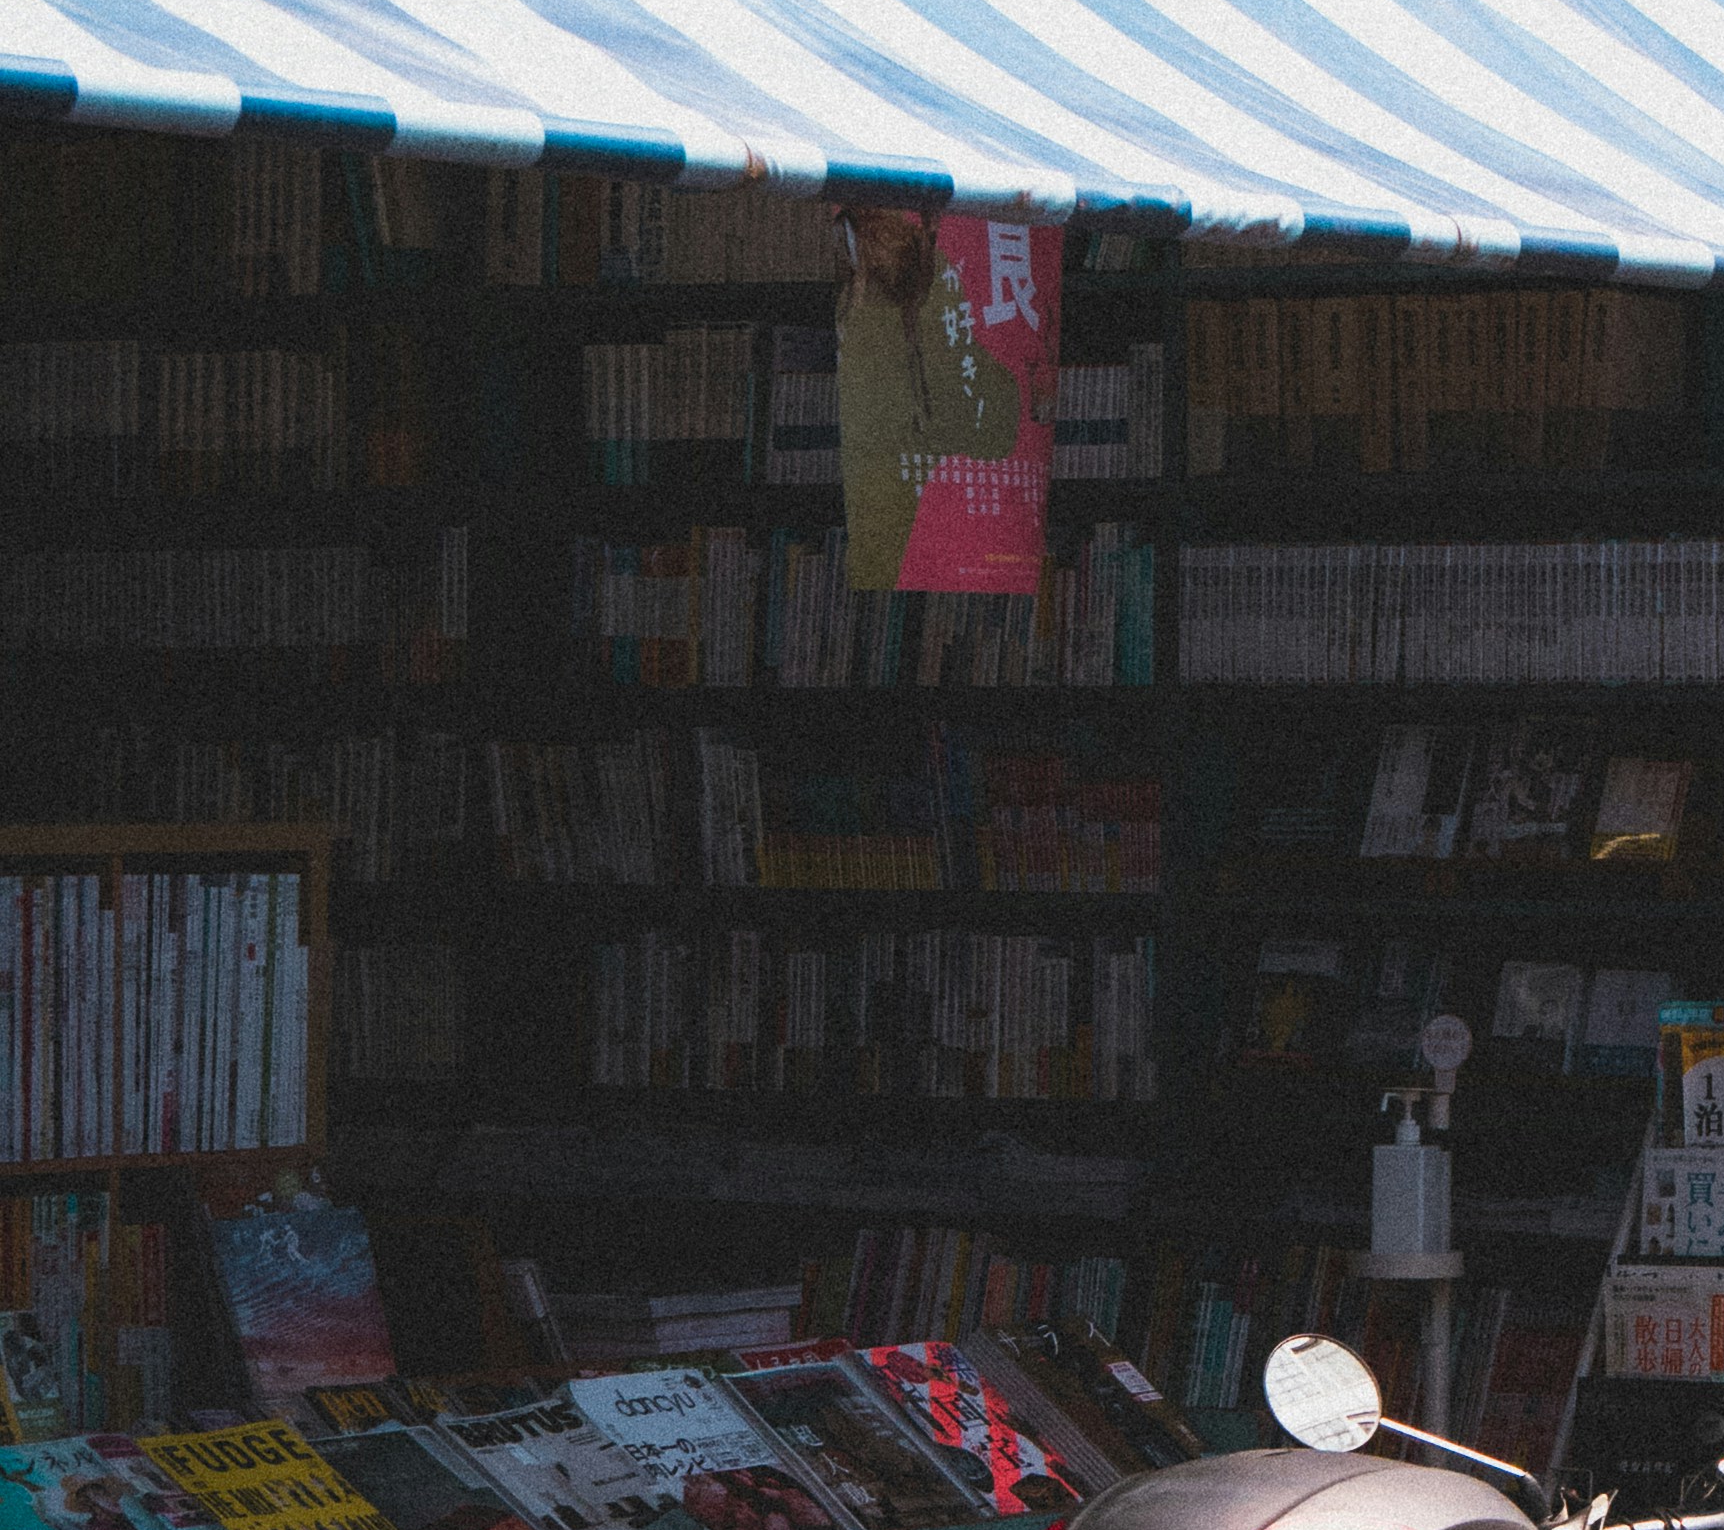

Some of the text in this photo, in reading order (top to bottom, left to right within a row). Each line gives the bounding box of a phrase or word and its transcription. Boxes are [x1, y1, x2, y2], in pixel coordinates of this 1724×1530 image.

[1693, 1072, 1723, 1145] 1泊
[446, 1402, 584, 1448] BRUTUS
[614, 1388, 696, 1417] dancyu
[158, 1428, 313, 1476] FUDGE
